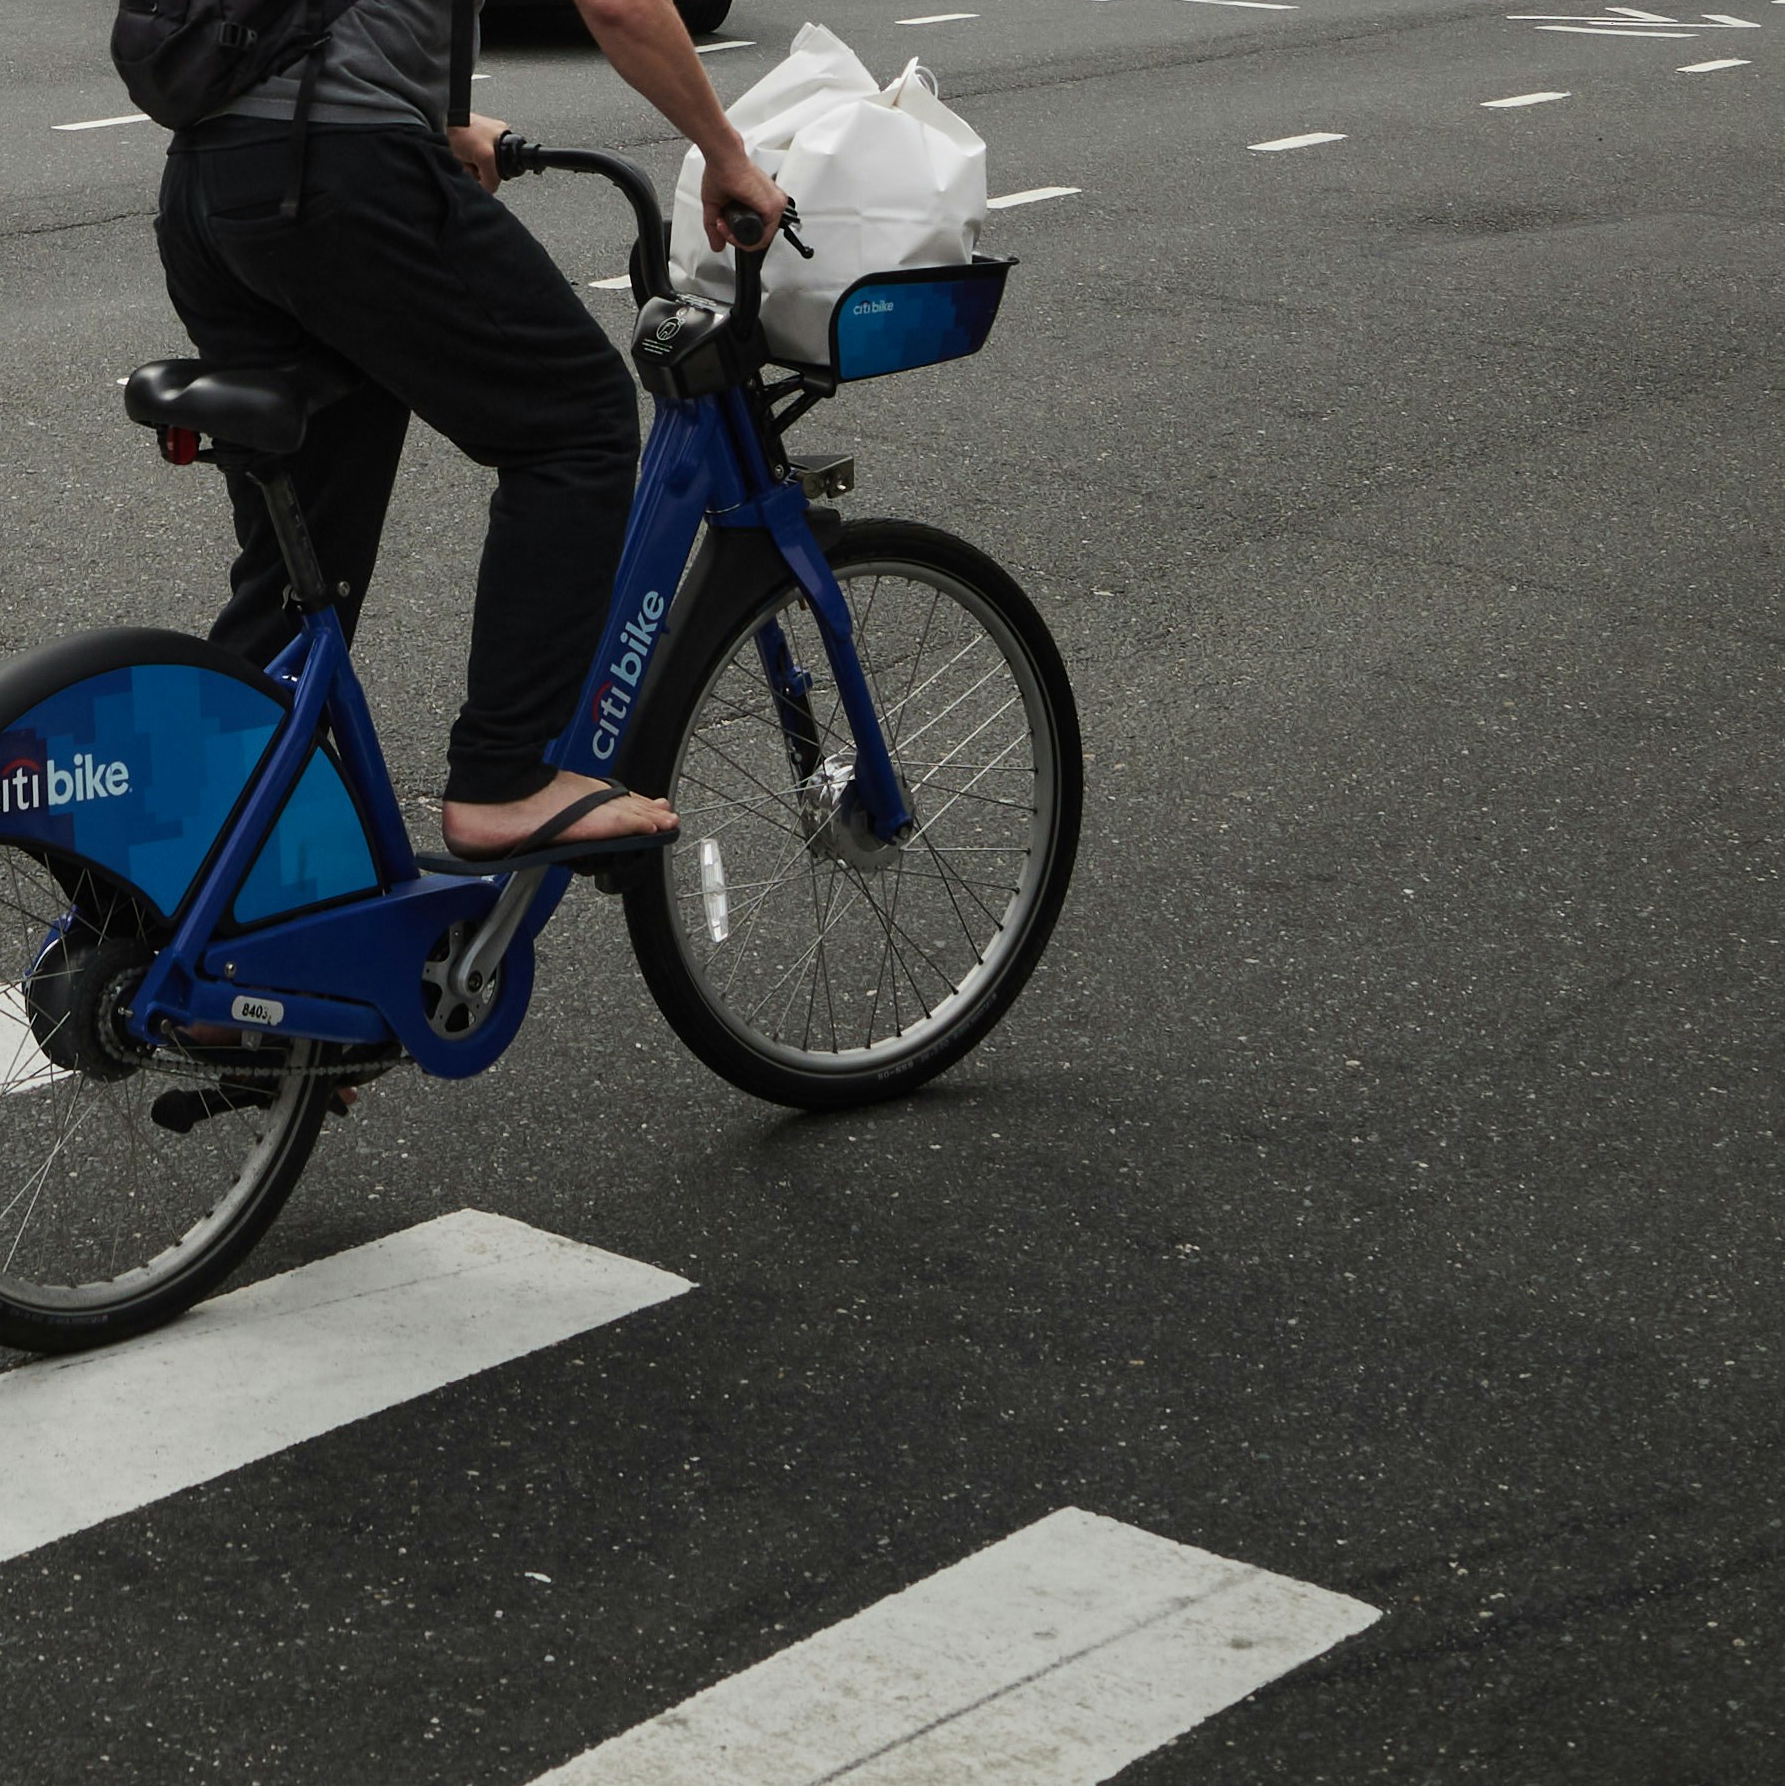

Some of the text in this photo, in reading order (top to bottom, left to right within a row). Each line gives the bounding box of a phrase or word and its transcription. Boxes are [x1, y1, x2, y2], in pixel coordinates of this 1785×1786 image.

[853, 299, 894, 315] citi bike
[592, 590, 665, 760] citi bike
[47, 753, 130, 806] bike
